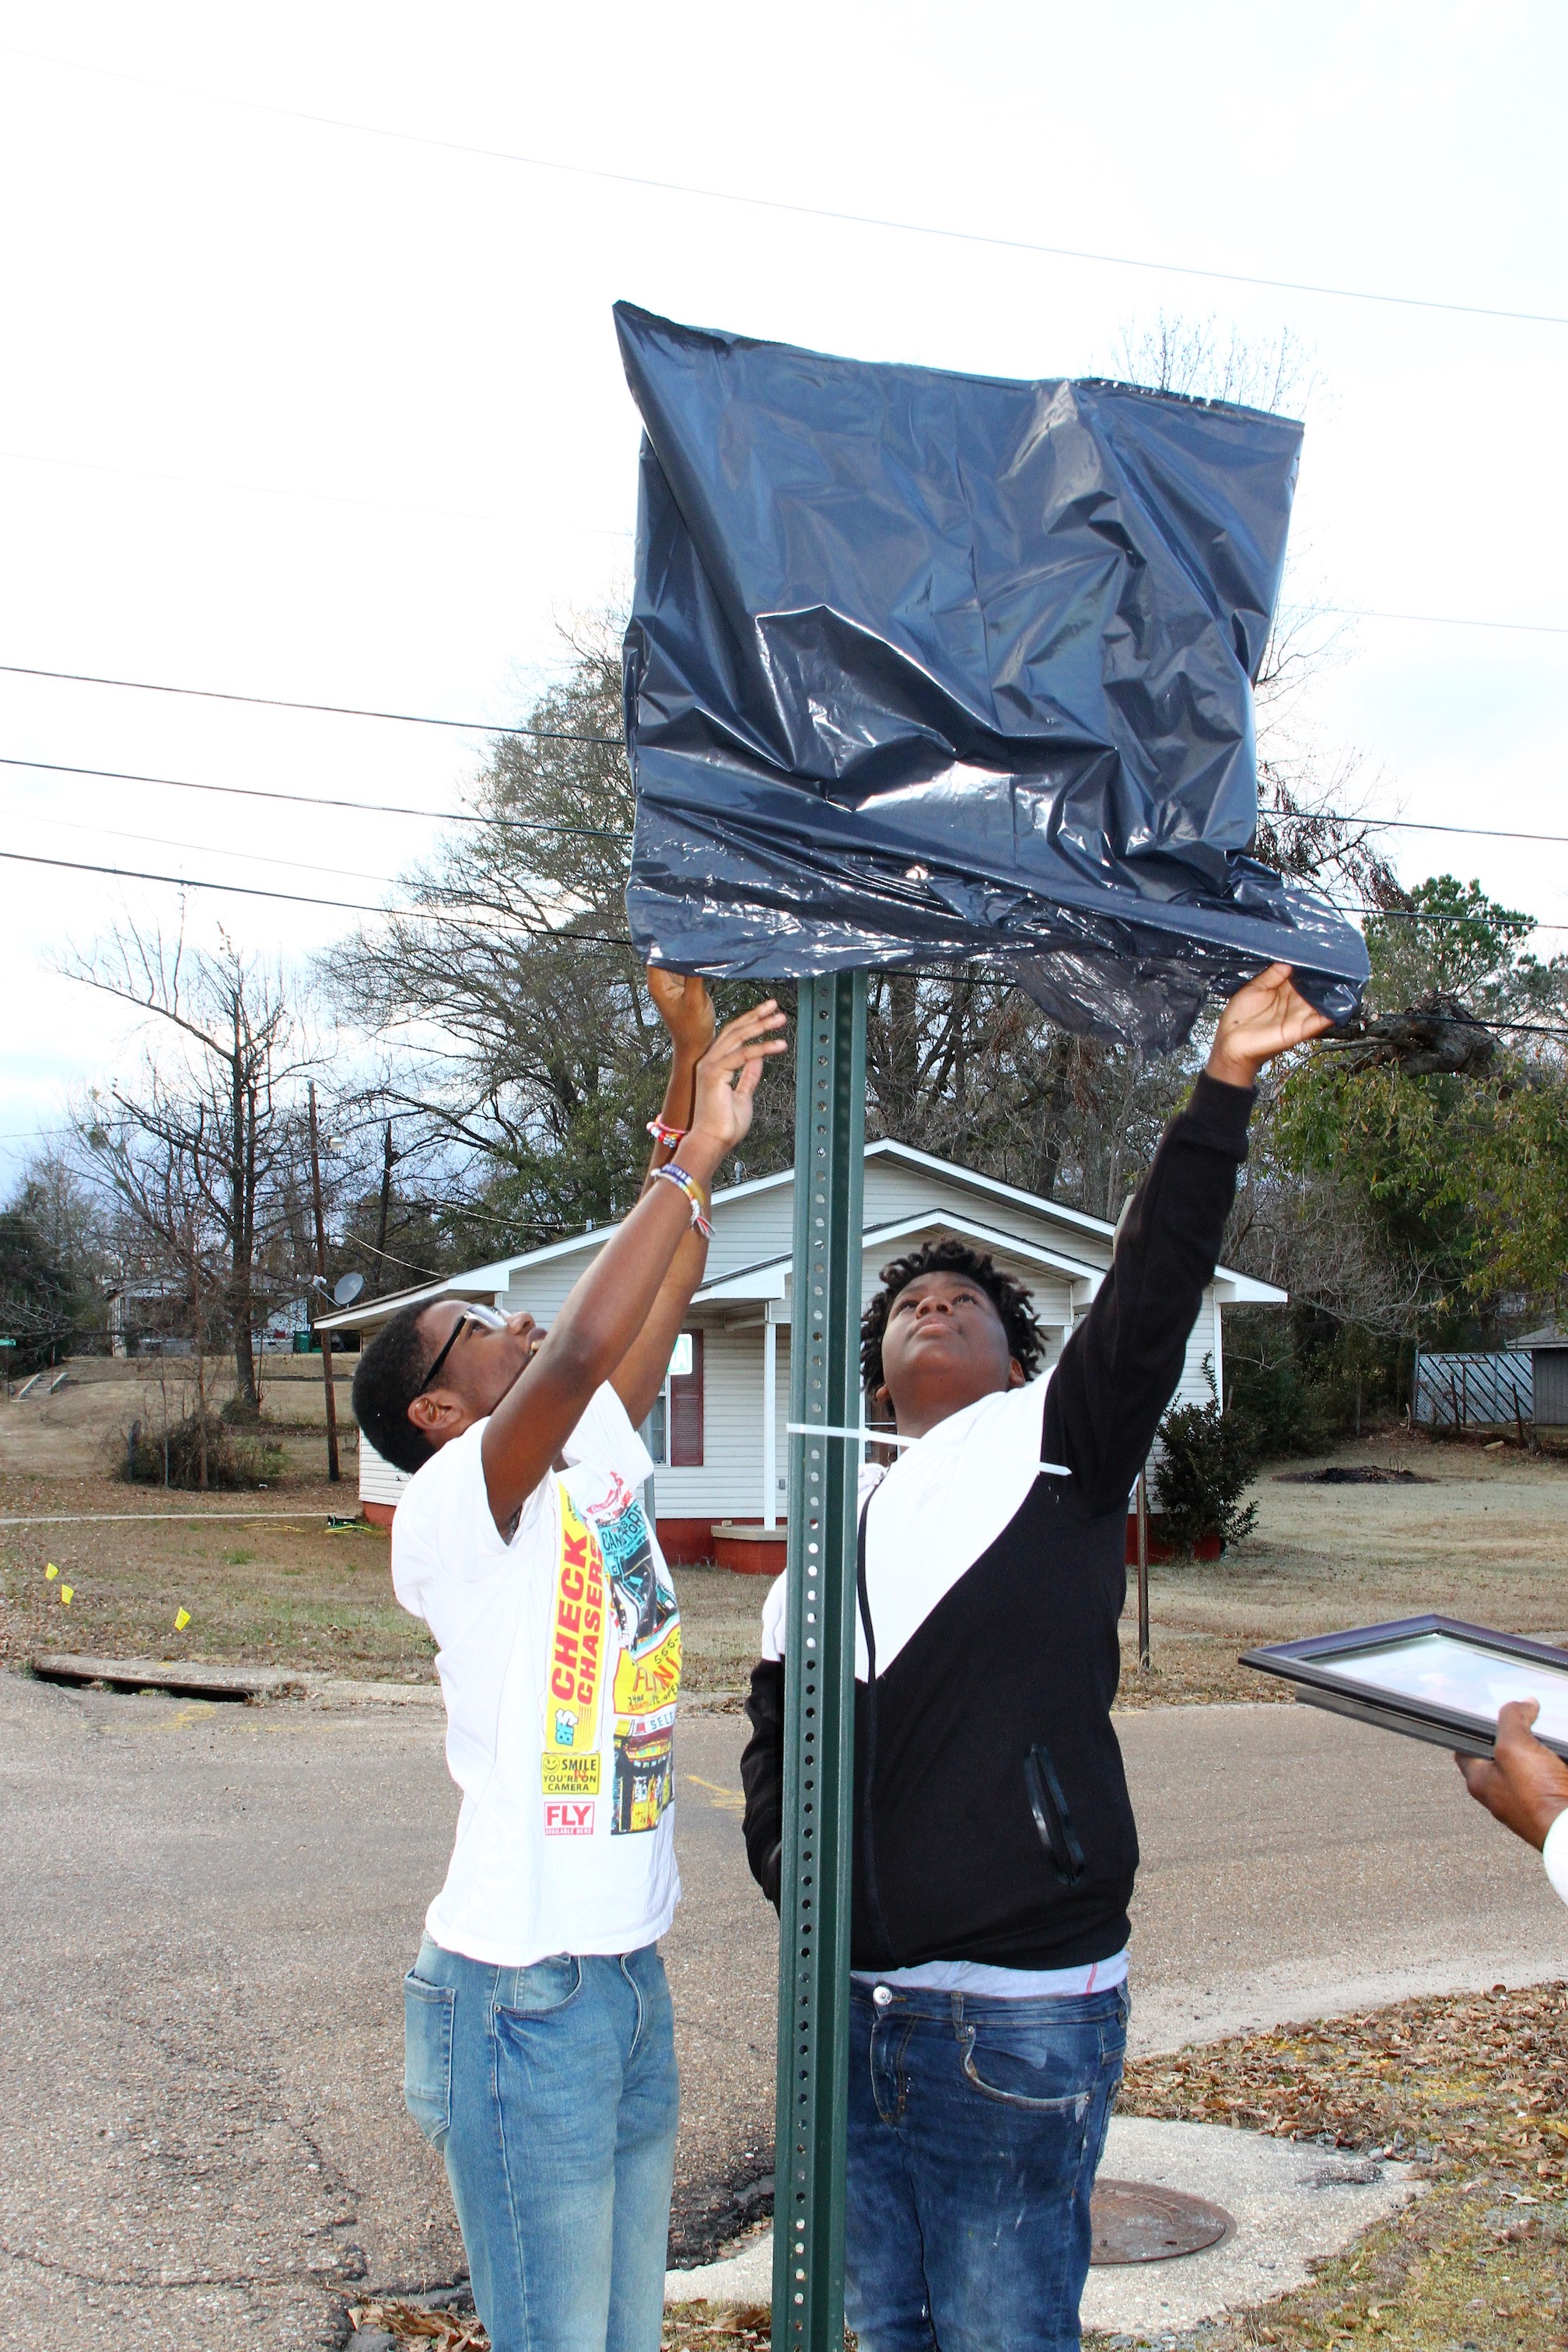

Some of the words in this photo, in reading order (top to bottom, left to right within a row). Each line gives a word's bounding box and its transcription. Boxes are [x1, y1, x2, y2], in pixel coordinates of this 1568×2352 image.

[551, 1529, 587, 1701] CHECK
[561, 1758, 597, 1771] SMILE
[543, 1774, 579, 1783] YOU'RE
[581, 1774, 597, 1783] ON
[547, 1783, 590, 1791] CAMERA
[547, 1804, 592, 1826] FLY
